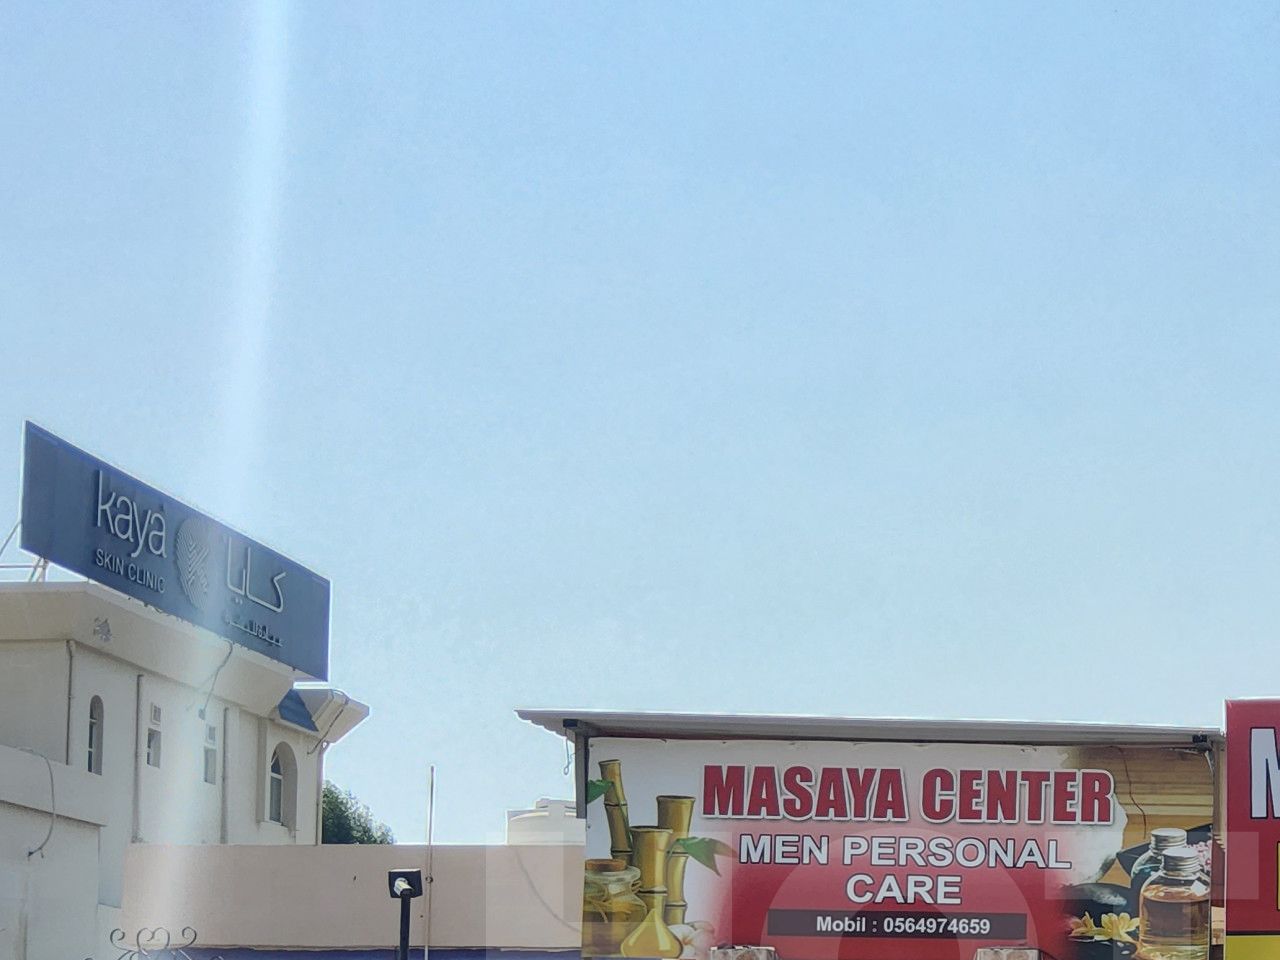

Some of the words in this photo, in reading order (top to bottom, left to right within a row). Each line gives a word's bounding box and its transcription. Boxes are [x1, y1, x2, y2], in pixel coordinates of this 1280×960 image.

[97, 470, 167, 558] kaya
[96, 548, 124, 576] SKIN
[128, 563, 165, 594] CLINIC
[702, 764, 909, 821] MASAYA
[921, 768, 1116, 825] CENTER
[739, 834, 828, 865] MEN
[843, 835, 1072, 870] PERSONAL
[845, 873, 962, 905] CARE
[816, 915, 867, 933] Mobil
[883, 916, 991, 935] 0564974659
